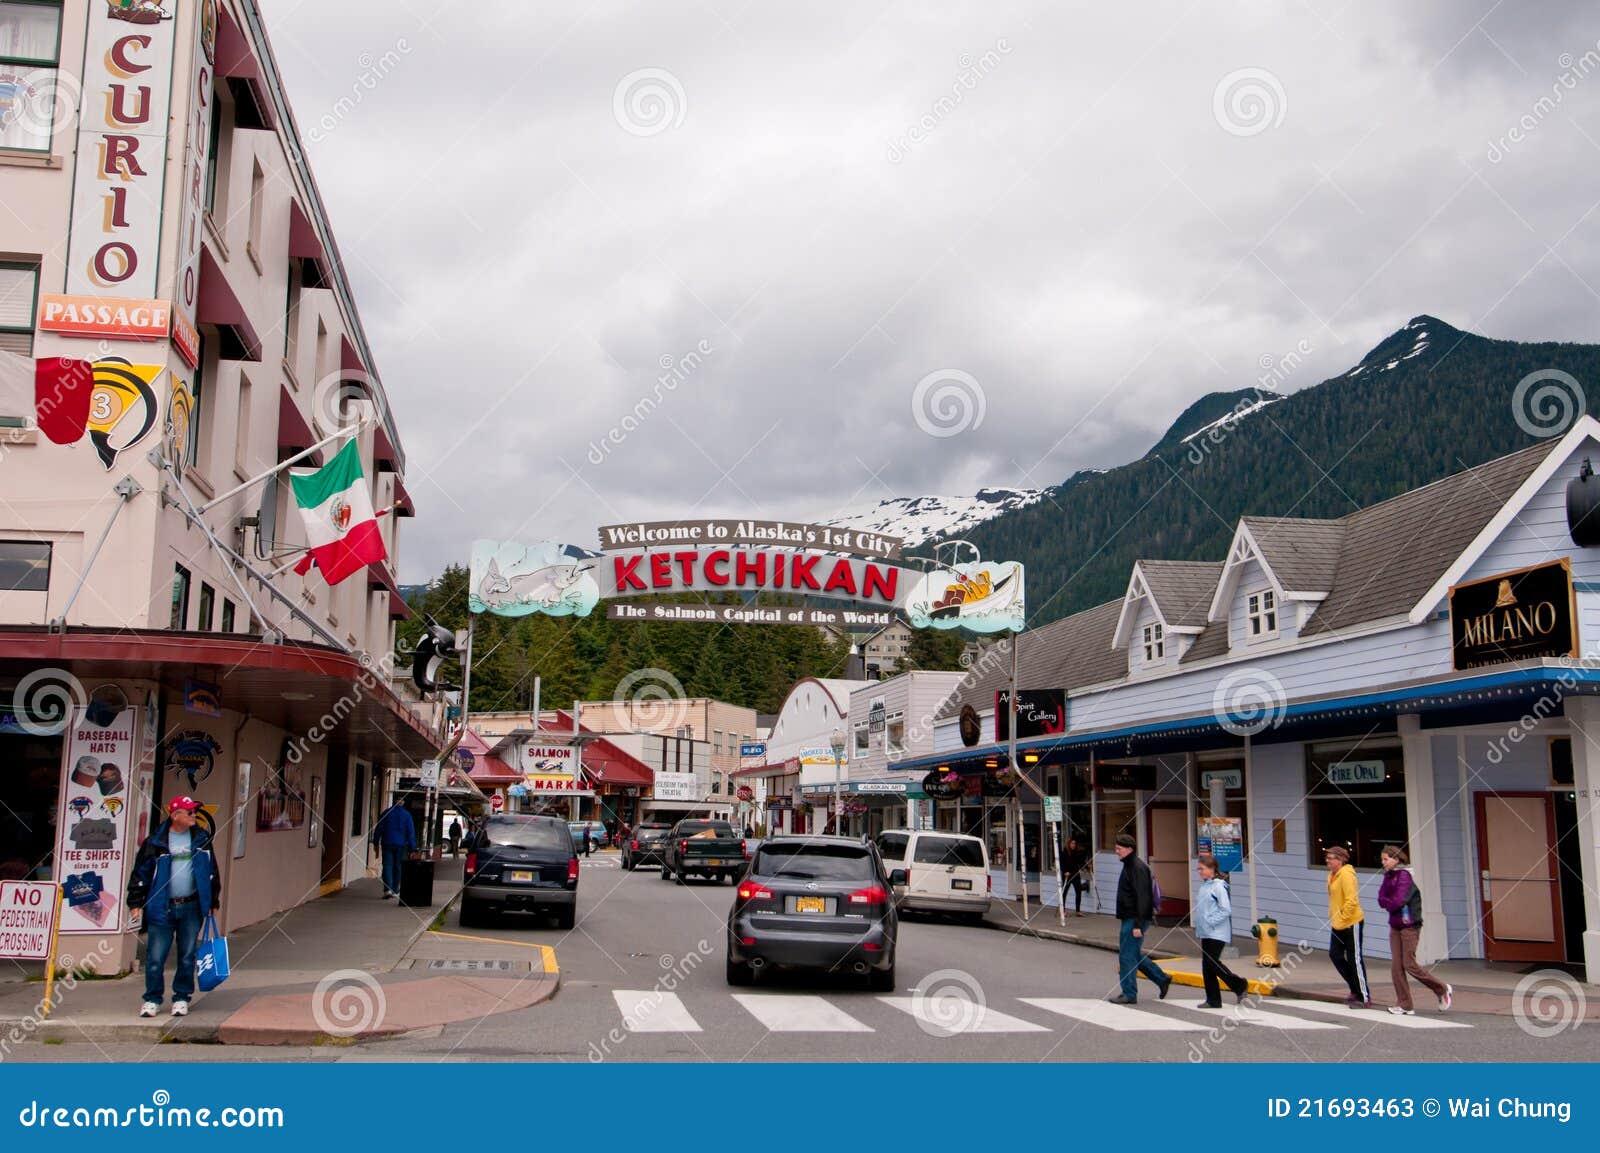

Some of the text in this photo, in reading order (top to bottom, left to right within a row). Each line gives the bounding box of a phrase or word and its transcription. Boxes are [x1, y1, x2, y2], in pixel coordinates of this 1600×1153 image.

[90, 34, 152, 287] CURIO
[45, 302, 165, 328] PASSAGE
[607, 521, 895, 559] Welcome to Alaska's 1st City
[614, 550, 898, 601] KETCHIKAN
[614, 604, 889, 624] The Salmon Capital of the World
[1464, 602, 1556, 648] MILANO
[1028, 710, 1056, 722] Gallery
[78, 731, 128, 741] BASEBALL
[90, 743, 116, 753] HATS
[528, 748, 571, 758] SALMON
[1330, 764, 1378, 780] FIRE OPAL
[65, 850, 121, 861] TEE SHIRTS
[14, 889, 41, 906] NO
[1, 910, 49, 928] PEDESTRIAN
[0, 932, 43, 951] CROSSING
